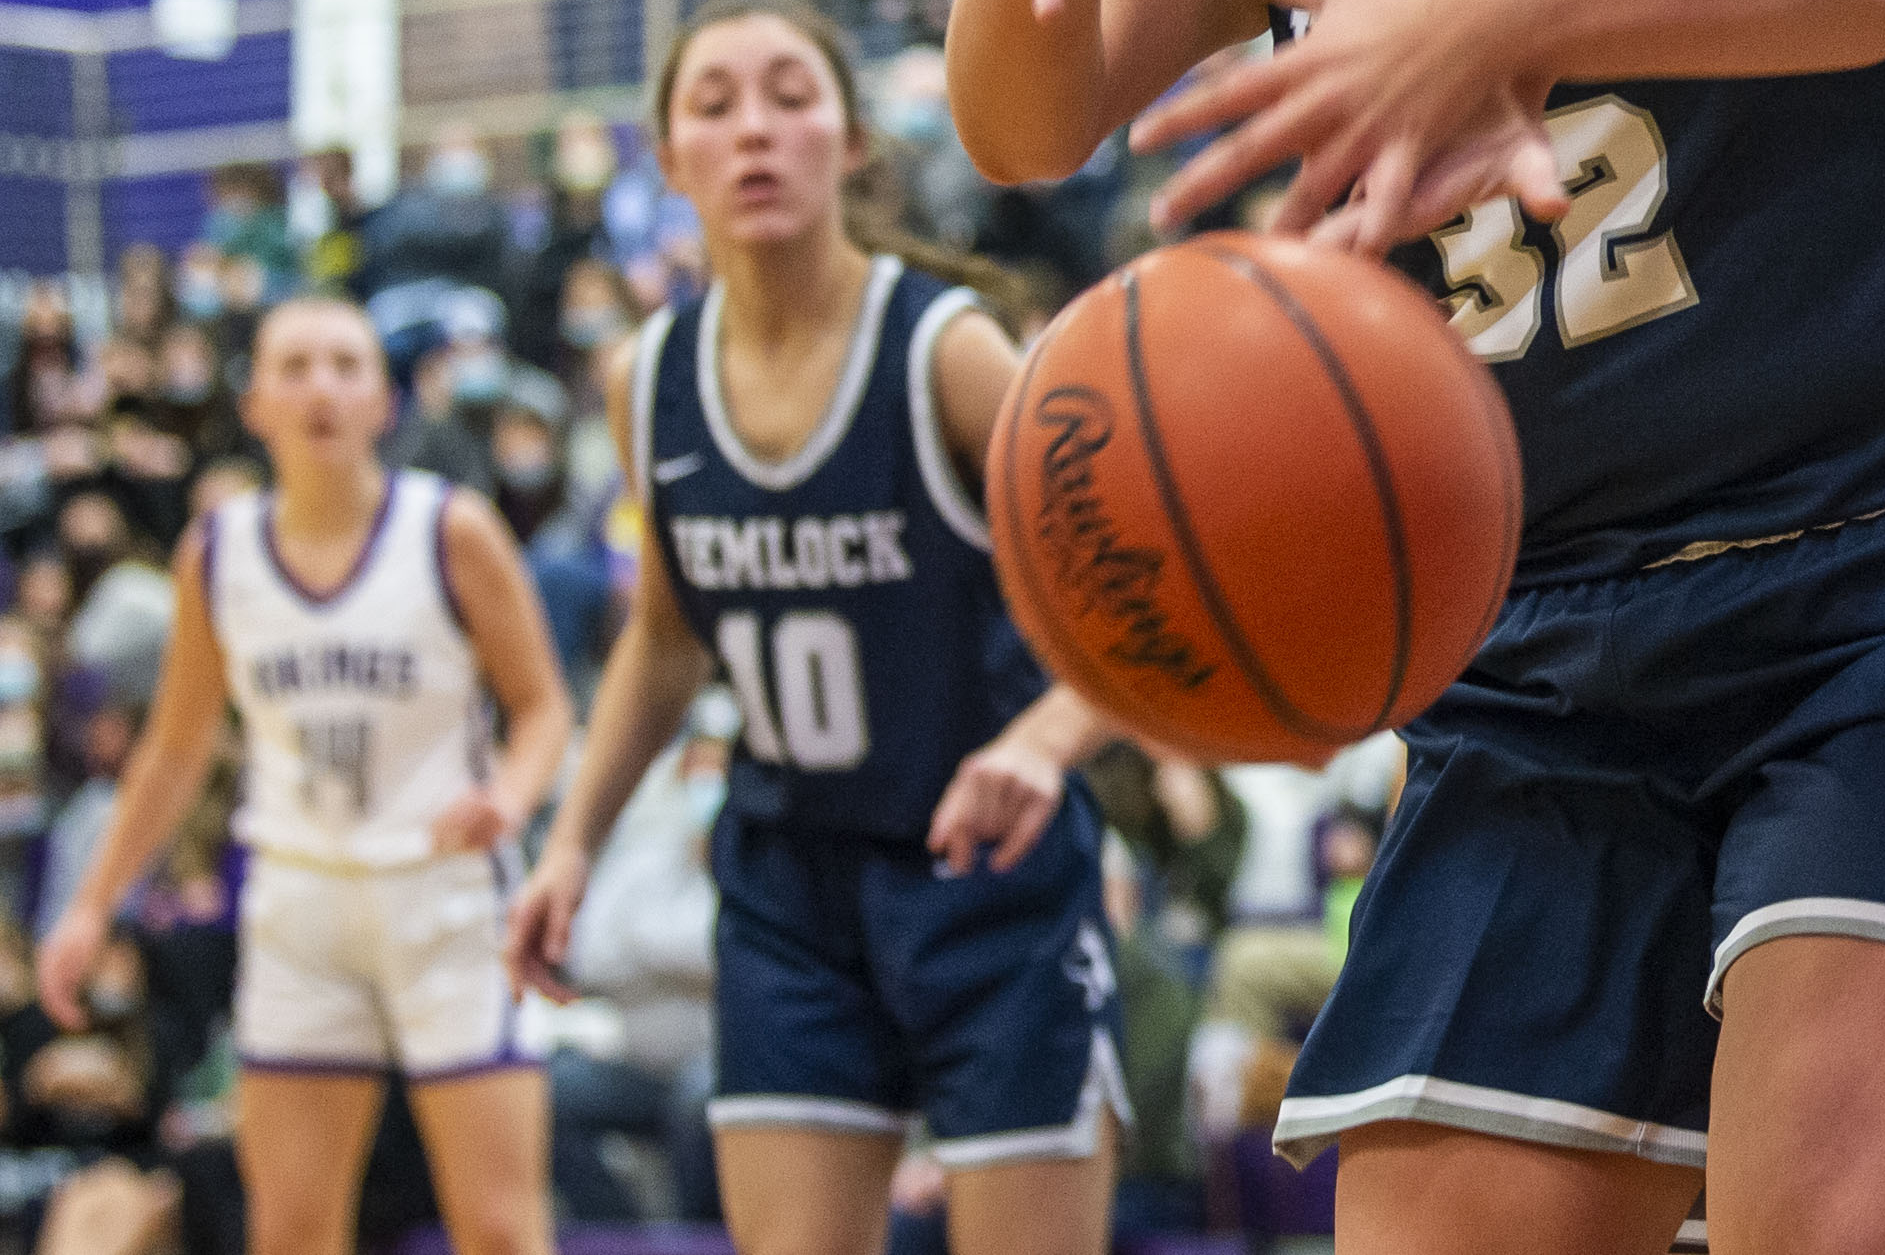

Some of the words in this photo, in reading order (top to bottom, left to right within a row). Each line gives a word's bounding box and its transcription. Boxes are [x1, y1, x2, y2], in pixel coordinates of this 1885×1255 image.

[1430, 92, 1699, 364] 32
[1036, 383, 1216, 690] Rawlings
[716, 609, 870, 773] 10
